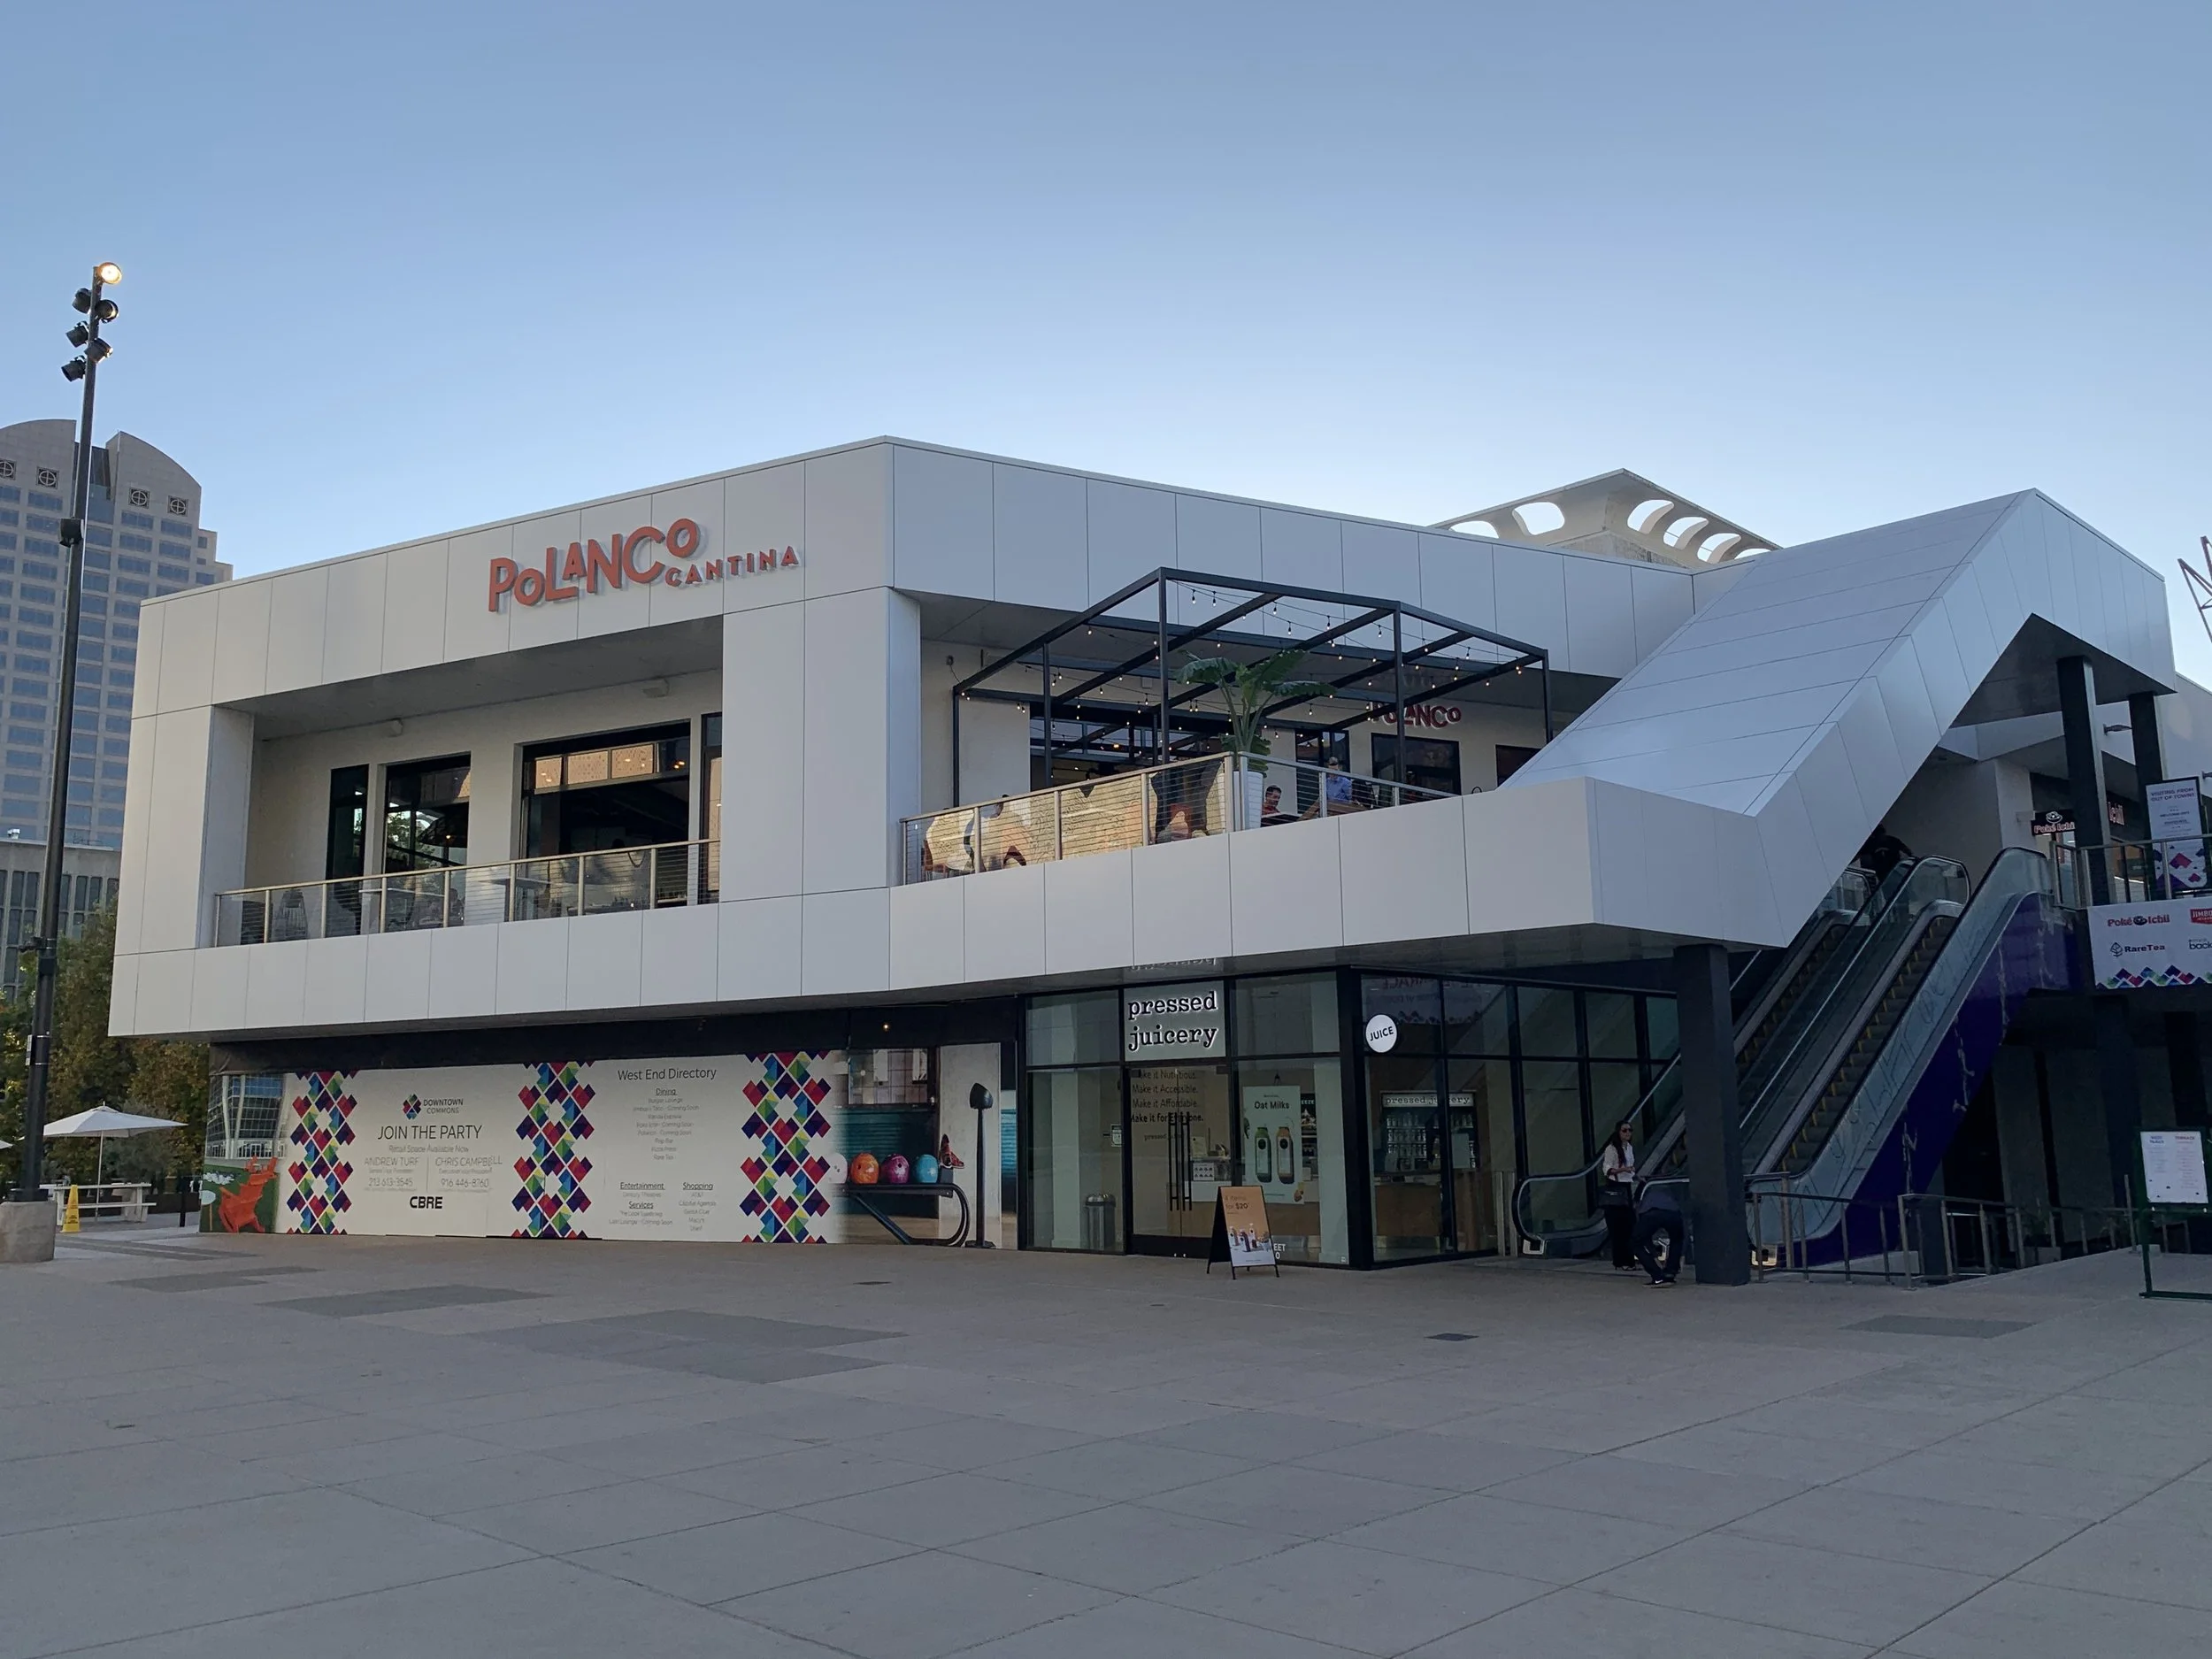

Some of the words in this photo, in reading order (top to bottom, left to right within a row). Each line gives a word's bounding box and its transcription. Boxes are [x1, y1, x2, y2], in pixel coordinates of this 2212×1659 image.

[664, 545, 800, 588] CANTINA
[2108, 918, 2132, 926] Poké
[1128, 990, 1218, 1021] pressed
[1128, 1024, 1218, 1052] juicery
[1370, 1026, 1394, 1041] JUICE
[618, 1070, 642, 1080] West
[645, 1069, 665, 1079] End
[669, 1068, 717, 1080] Directory
[1133, 1084, 1151, 1094] Make
[423, 1098, 464, 1107] DOWNTOWN
[1133, 1099, 1151, 1108] Make
[1153, 1099, 1158, 1108] it
[1254, 1101, 1268, 1110] Oat
[1270, 1101, 1290, 1110] Milks
[1386, 1096, 1425, 1106] pressed
[1156, 1113, 1168, 1122] for
[377, 1125, 408, 1140] JOIN
[411, 1125, 436, 1140] THE
[440, 1125, 483, 1140] PARTY
[364, 1157, 398, 1166] ANDREW
[434, 1157, 459, 1166] CHRIS
[620, 1181, 665, 1190] Entertainment
[682, 1181, 714, 1190] Shopping
[409, 1196, 443, 1210] CBRE
[628, 1201, 654, 1210] Services
